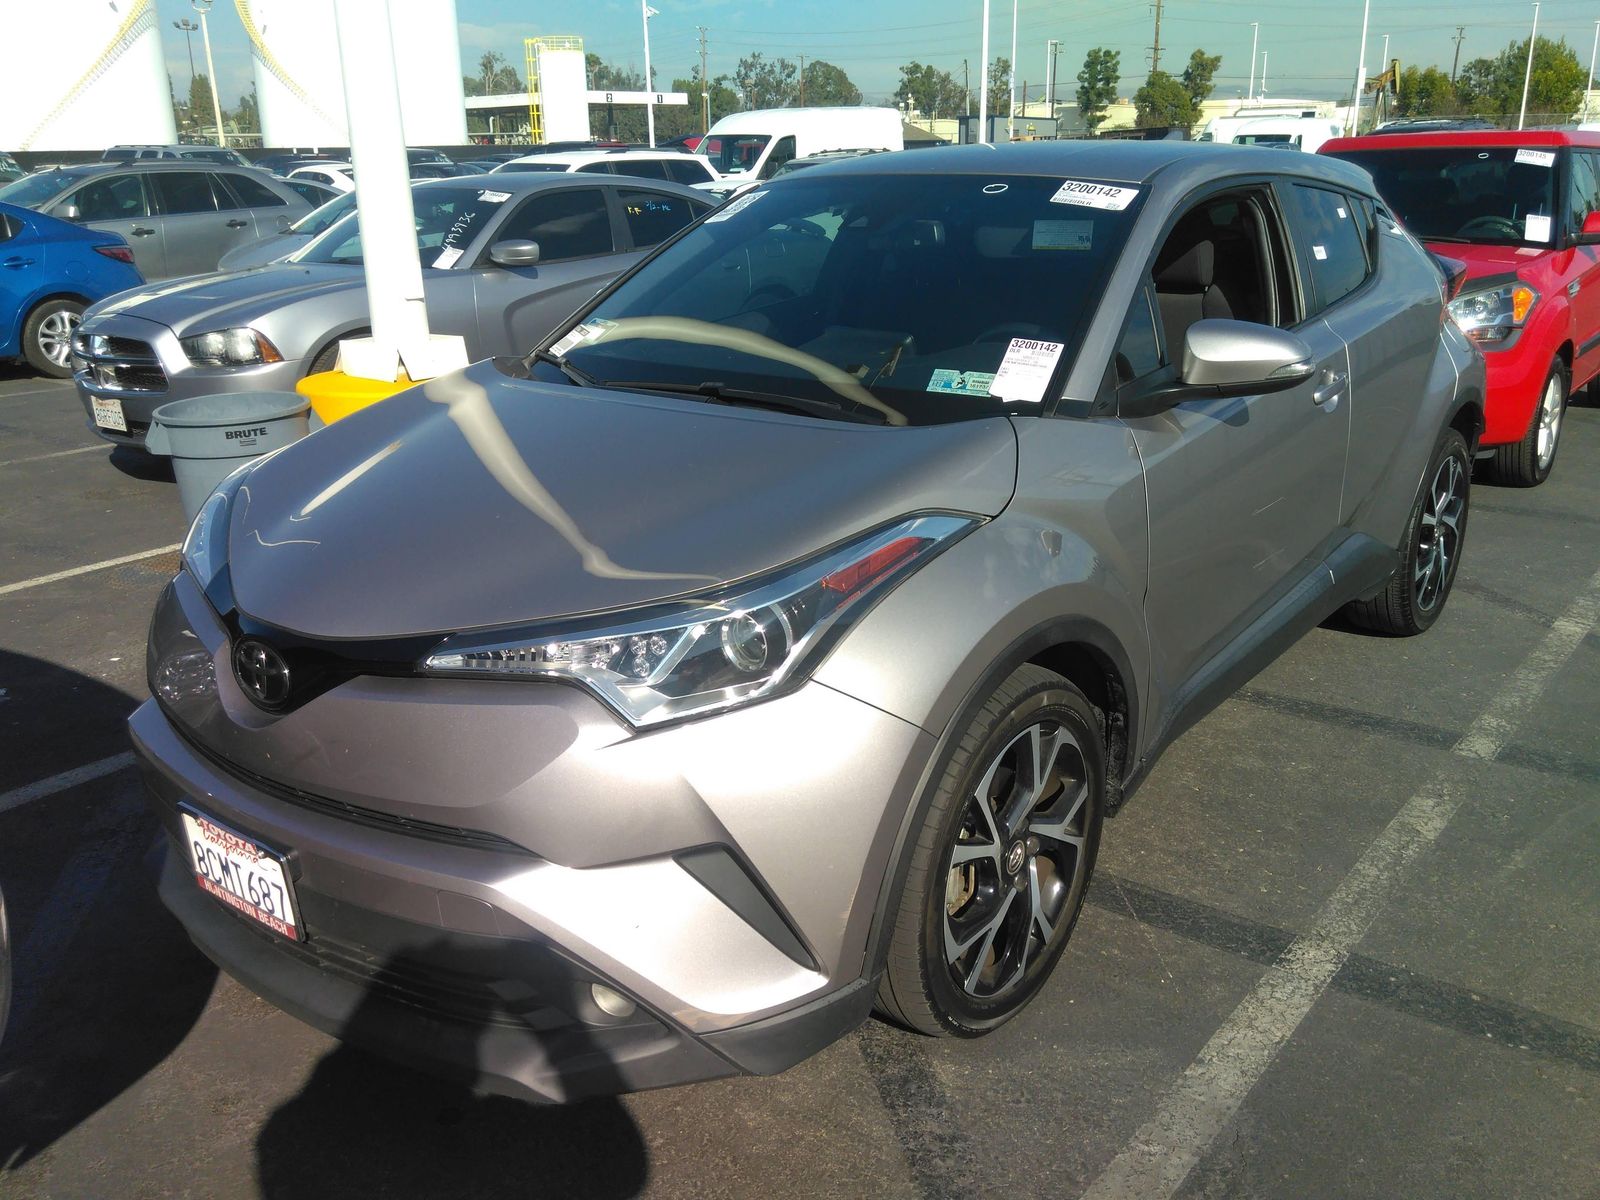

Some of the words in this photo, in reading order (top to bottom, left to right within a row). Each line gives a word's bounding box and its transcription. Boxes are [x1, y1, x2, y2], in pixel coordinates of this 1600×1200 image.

[1062, 182, 1121, 198] 3200142
[1012, 339, 1058, 353] 3200142
[225, 427, 268, 440] BRUTE
[199, 817, 258, 856] TOYOTA
[193, 841, 287, 922] 8CMT687
[204, 879, 258, 919] HUNTINGTON
[258, 909, 288, 936] BEACH
